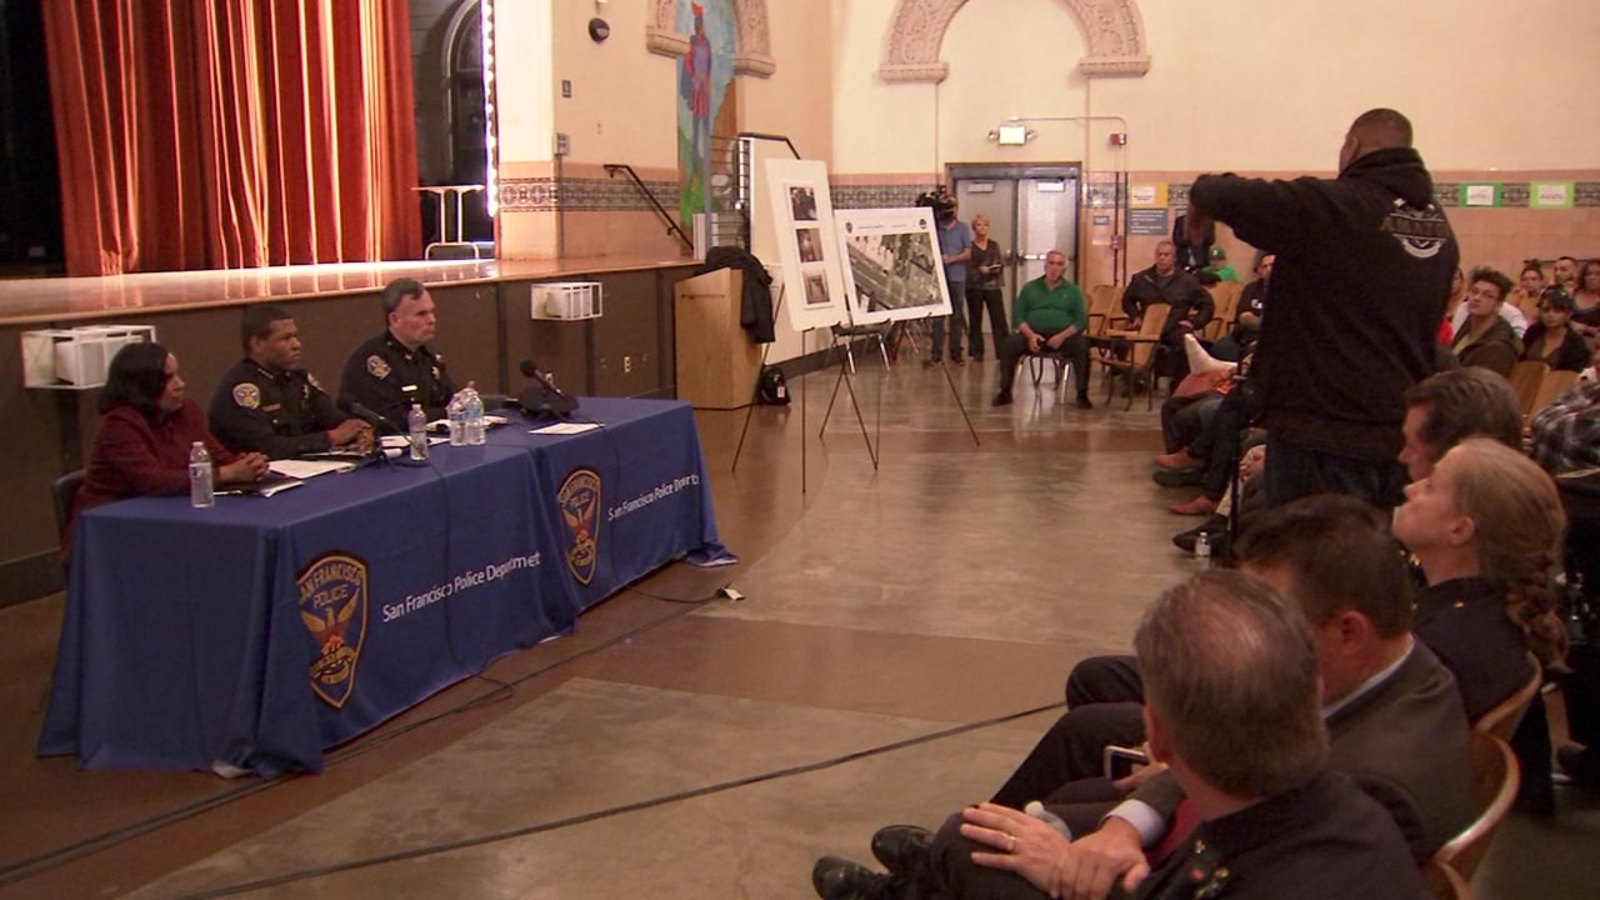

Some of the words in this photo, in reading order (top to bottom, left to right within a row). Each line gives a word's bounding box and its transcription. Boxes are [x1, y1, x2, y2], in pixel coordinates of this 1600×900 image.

[313, 583, 349, 610] POLICE
[383, 604, 405, 623] San
[405, 585, 453, 614] Francisco
[454, 571, 485, 593] Police
